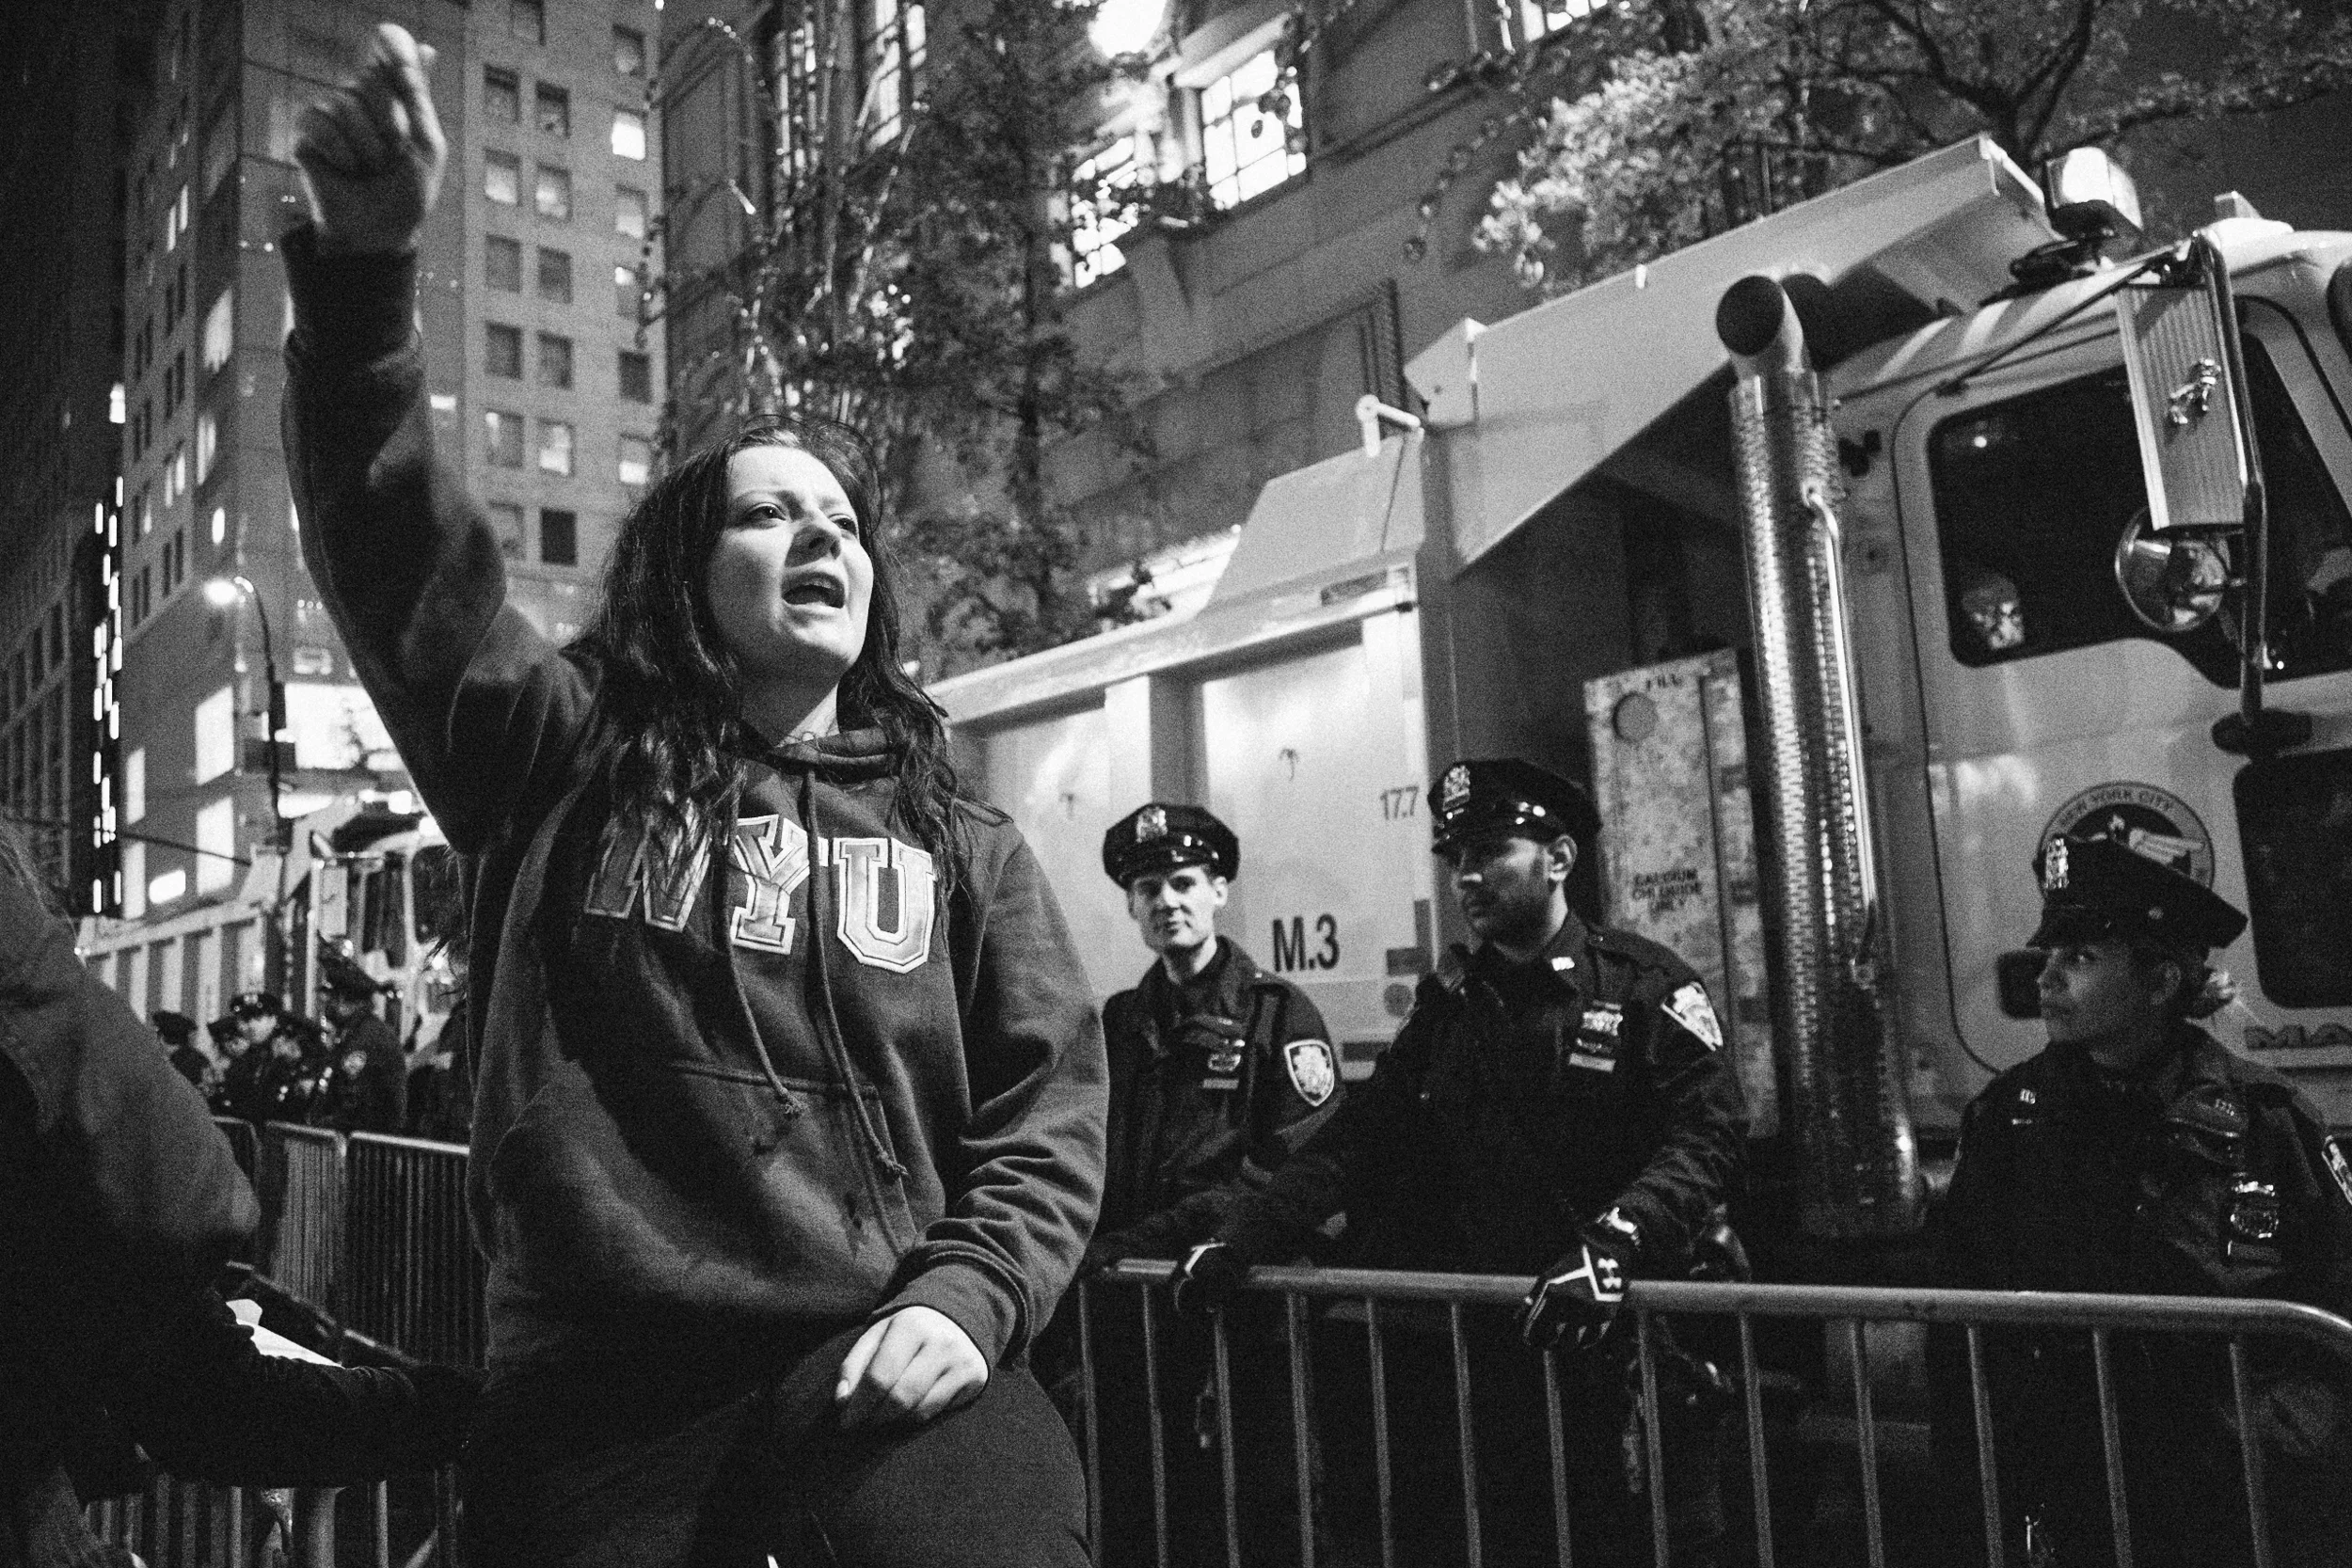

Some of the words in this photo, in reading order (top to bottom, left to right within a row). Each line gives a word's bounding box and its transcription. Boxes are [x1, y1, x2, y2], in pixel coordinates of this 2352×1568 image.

[2090, 788, 2134, 804] YORK
[2137, 789, 2175, 813] CITY
[583, 813, 937, 974] NYU
[1272, 913, 1340, 973] M.3
